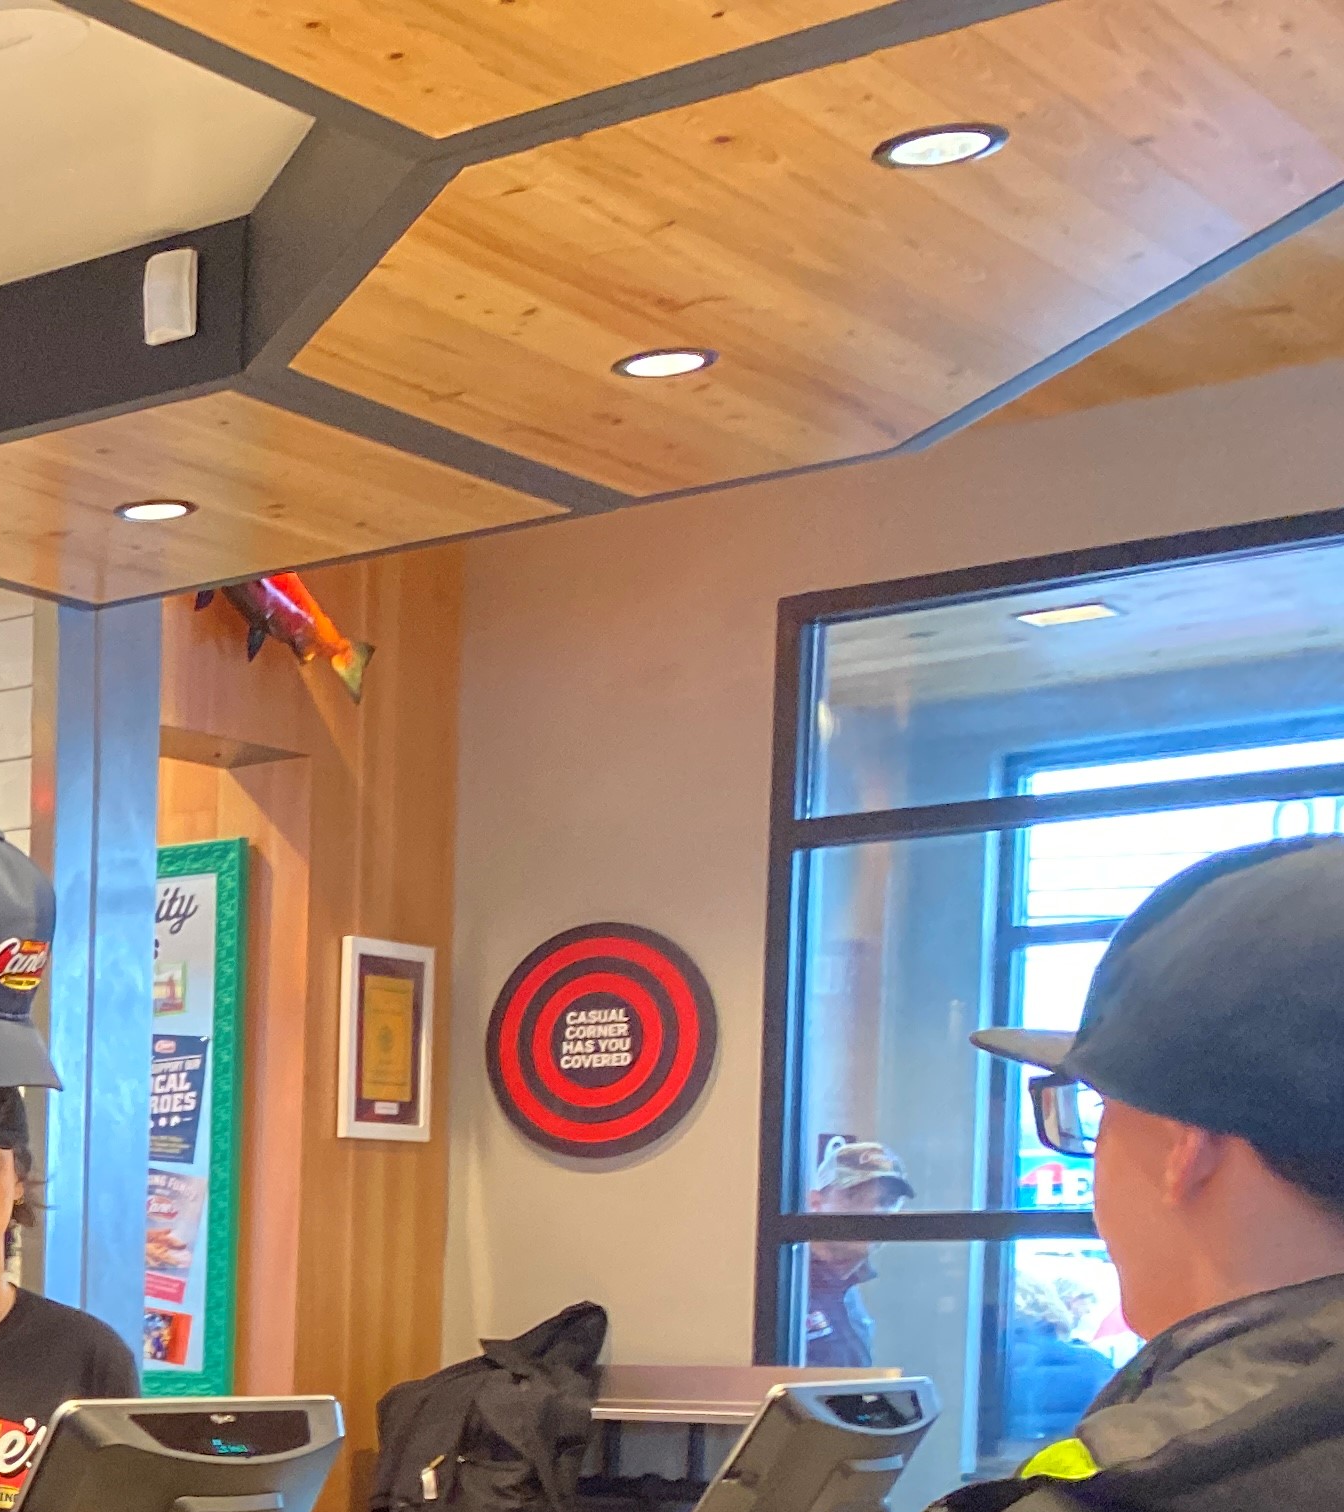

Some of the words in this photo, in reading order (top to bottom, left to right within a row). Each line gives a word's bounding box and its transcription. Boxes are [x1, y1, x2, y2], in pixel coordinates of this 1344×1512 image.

[566, 1008, 630, 1025] CASUAL
[565, 1023, 629, 1040] CORNER
[562, 1039, 596, 1055] HAS
[597, 1037, 631, 1052] YOU
[560, 1052, 633, 1069] COVERED
